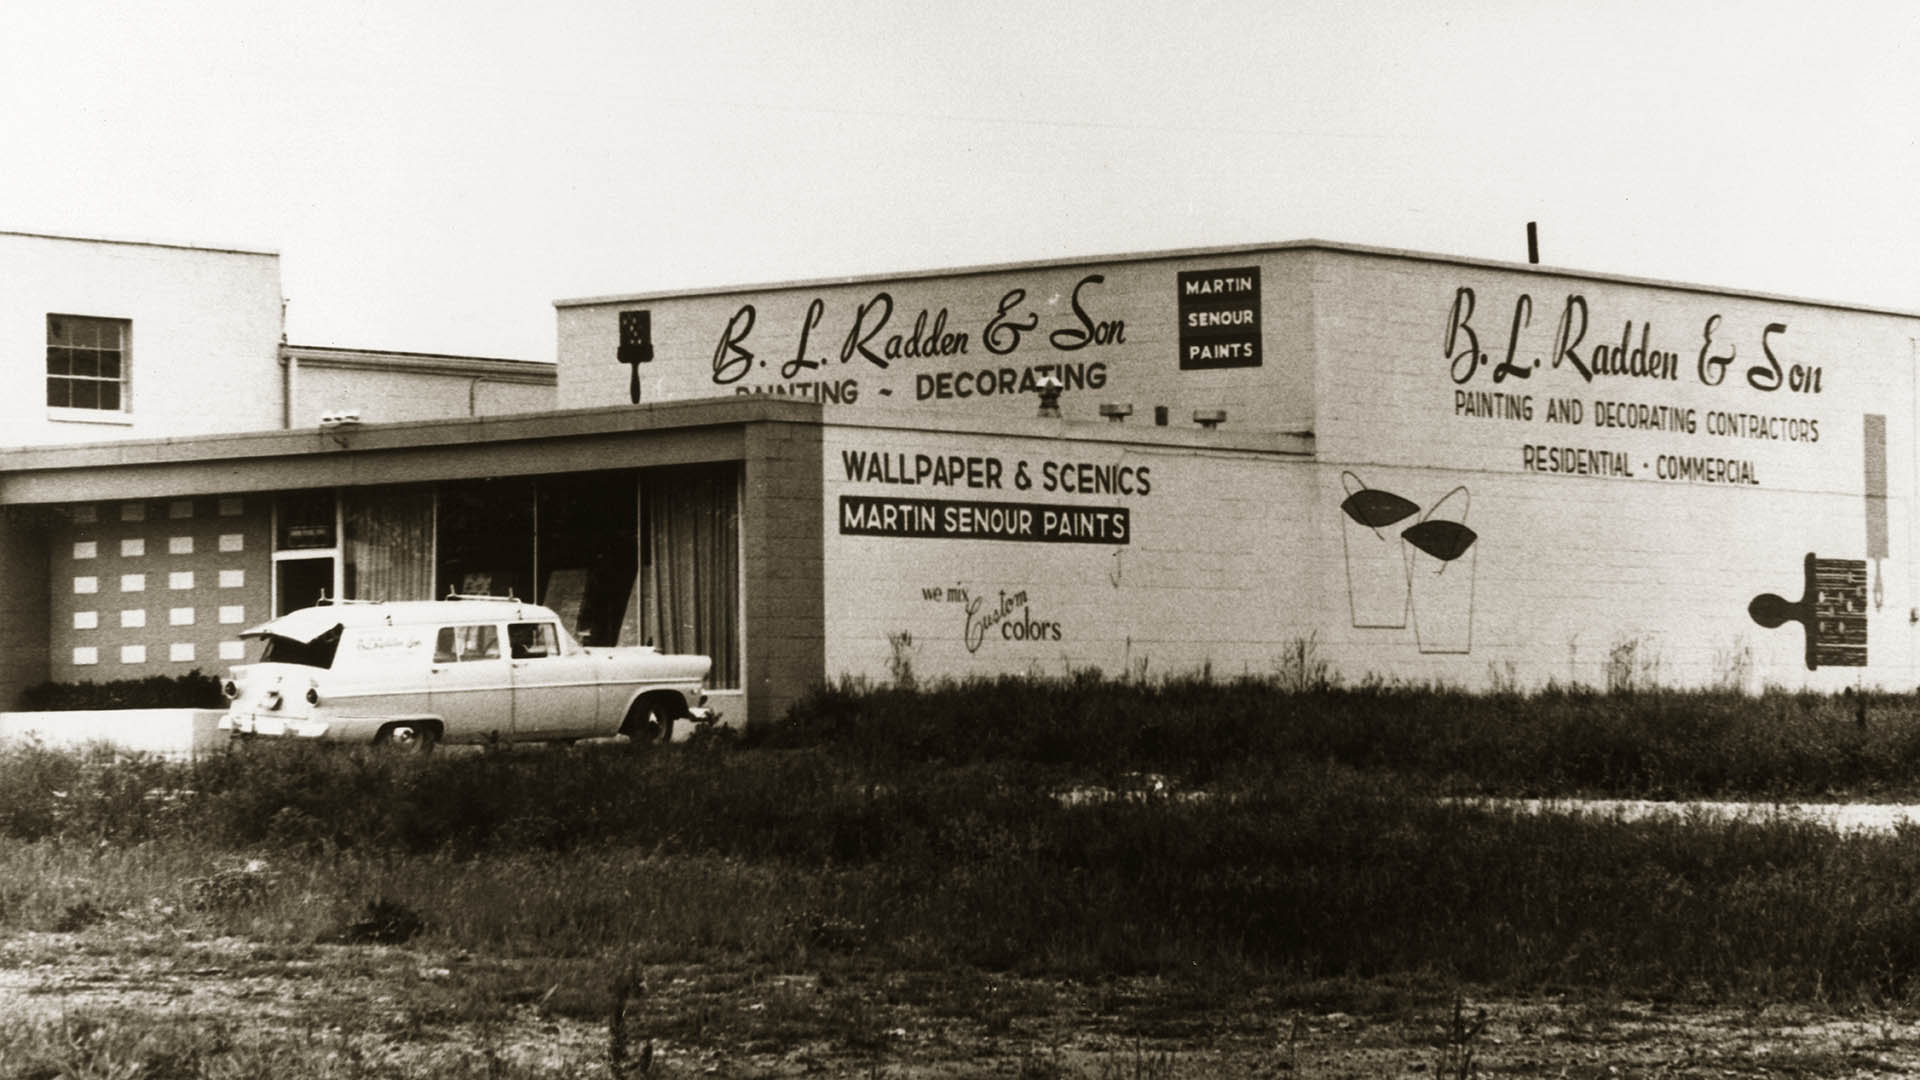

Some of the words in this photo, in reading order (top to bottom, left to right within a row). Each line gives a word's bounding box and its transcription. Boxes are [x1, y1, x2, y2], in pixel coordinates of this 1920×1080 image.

[1185, 276, 1253, 296] MARTIN
[840, 291, 969, 369] Radden
[982, 288, 1039, 355] &
[1049, 274, 1127, 351] Son
[1187, 309, 1254, 328] SENOUR
[1188, 341, 1254, 360] PAINTS
[1552, 294, 1679, 383] Radden
[1697, 313, 1737, 387] &
[1746, 322, 1823, 394] Son
[915, 361, 1107, 401] DECORATING
[1454, 389, 1534, 422] PAINTING
[1545, 397, 1584, 425] AND
[1594, 400, 1697, 435] DECORATING
[1706, 410, 1820, 443] CONTRACTORS
[841, 449, 1003, 489] WALLPAPER
[1013, 460, 1032, 491] &
[1042, 460, 1152, 497] SCENICS
[1523, 444, 1635, 478] RESIDENTIAL
[1656, 454, 1760, 486] COMMERCIAL
[843, 503, 937, 533] MARTIN
[943, 506, 1034, 536] SENOUR
[1043, 511, 1126, 539] PAINTS
[921, 586, 943, 602] we
[946, 581, 970, 603] mix
[964, 589, 1029, 654] Custom
[1001, 605, 1063, 641] colors
